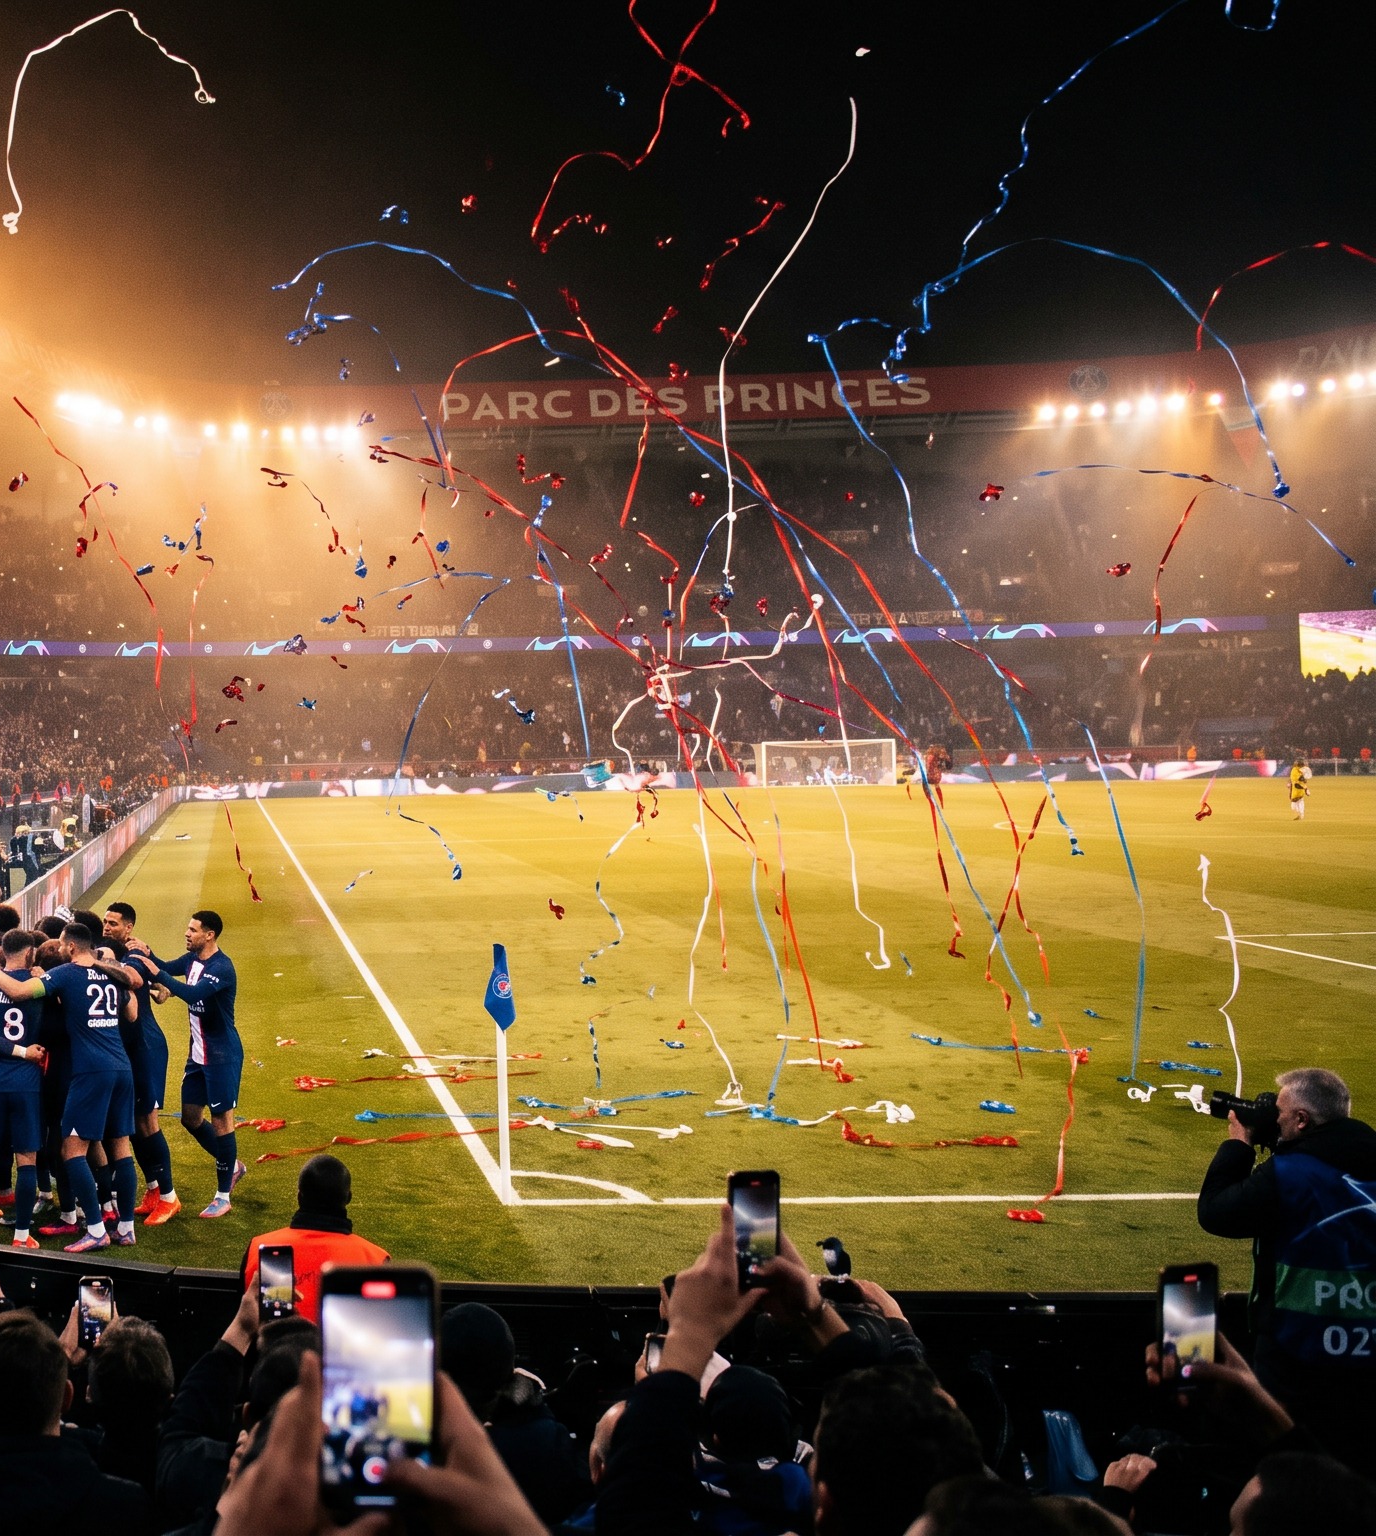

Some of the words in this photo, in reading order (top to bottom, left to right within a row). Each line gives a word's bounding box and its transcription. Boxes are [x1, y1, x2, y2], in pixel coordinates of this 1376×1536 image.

[444, 389, 572, 421] PARC
[589, 385, 687, 418] DES
[703, 377, 932, 415] PRINCES
[86, 983, 118, 1016] 20
[4, 1007, 25, 1041] 8
[1323, 1325, 1376, 1356] 02
